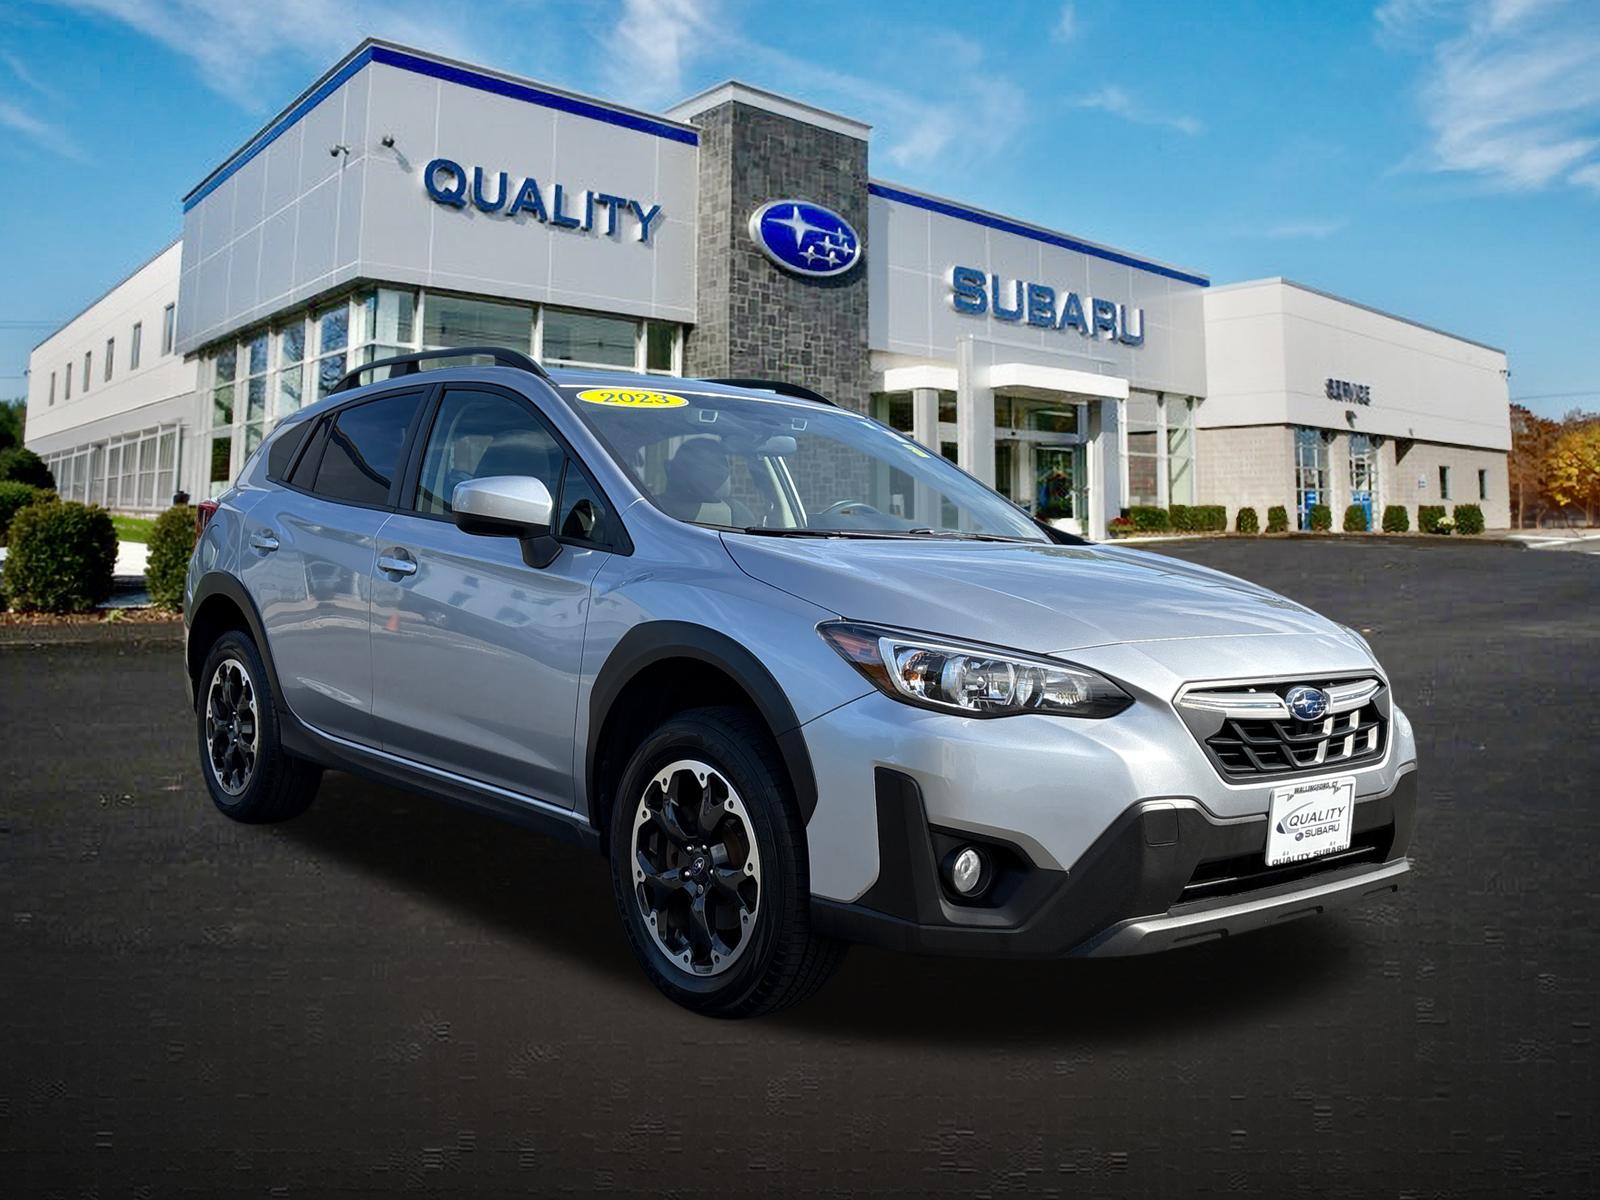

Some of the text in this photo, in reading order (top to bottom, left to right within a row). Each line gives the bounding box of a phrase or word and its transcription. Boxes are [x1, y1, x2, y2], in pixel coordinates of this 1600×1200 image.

[423, 158, 661, 242] QUALITY
[950, 265, 1144, 346] SUBARU
[600, 392, 670, 404] 2023
[1325, 377, 1371, 407] SERVICE
[1289, 805, 1346, 827] QUALITY
[1304, 823, 1340, 838] SUBARU
[1272, 844, 1348, 865] QUALITY SUBARU
